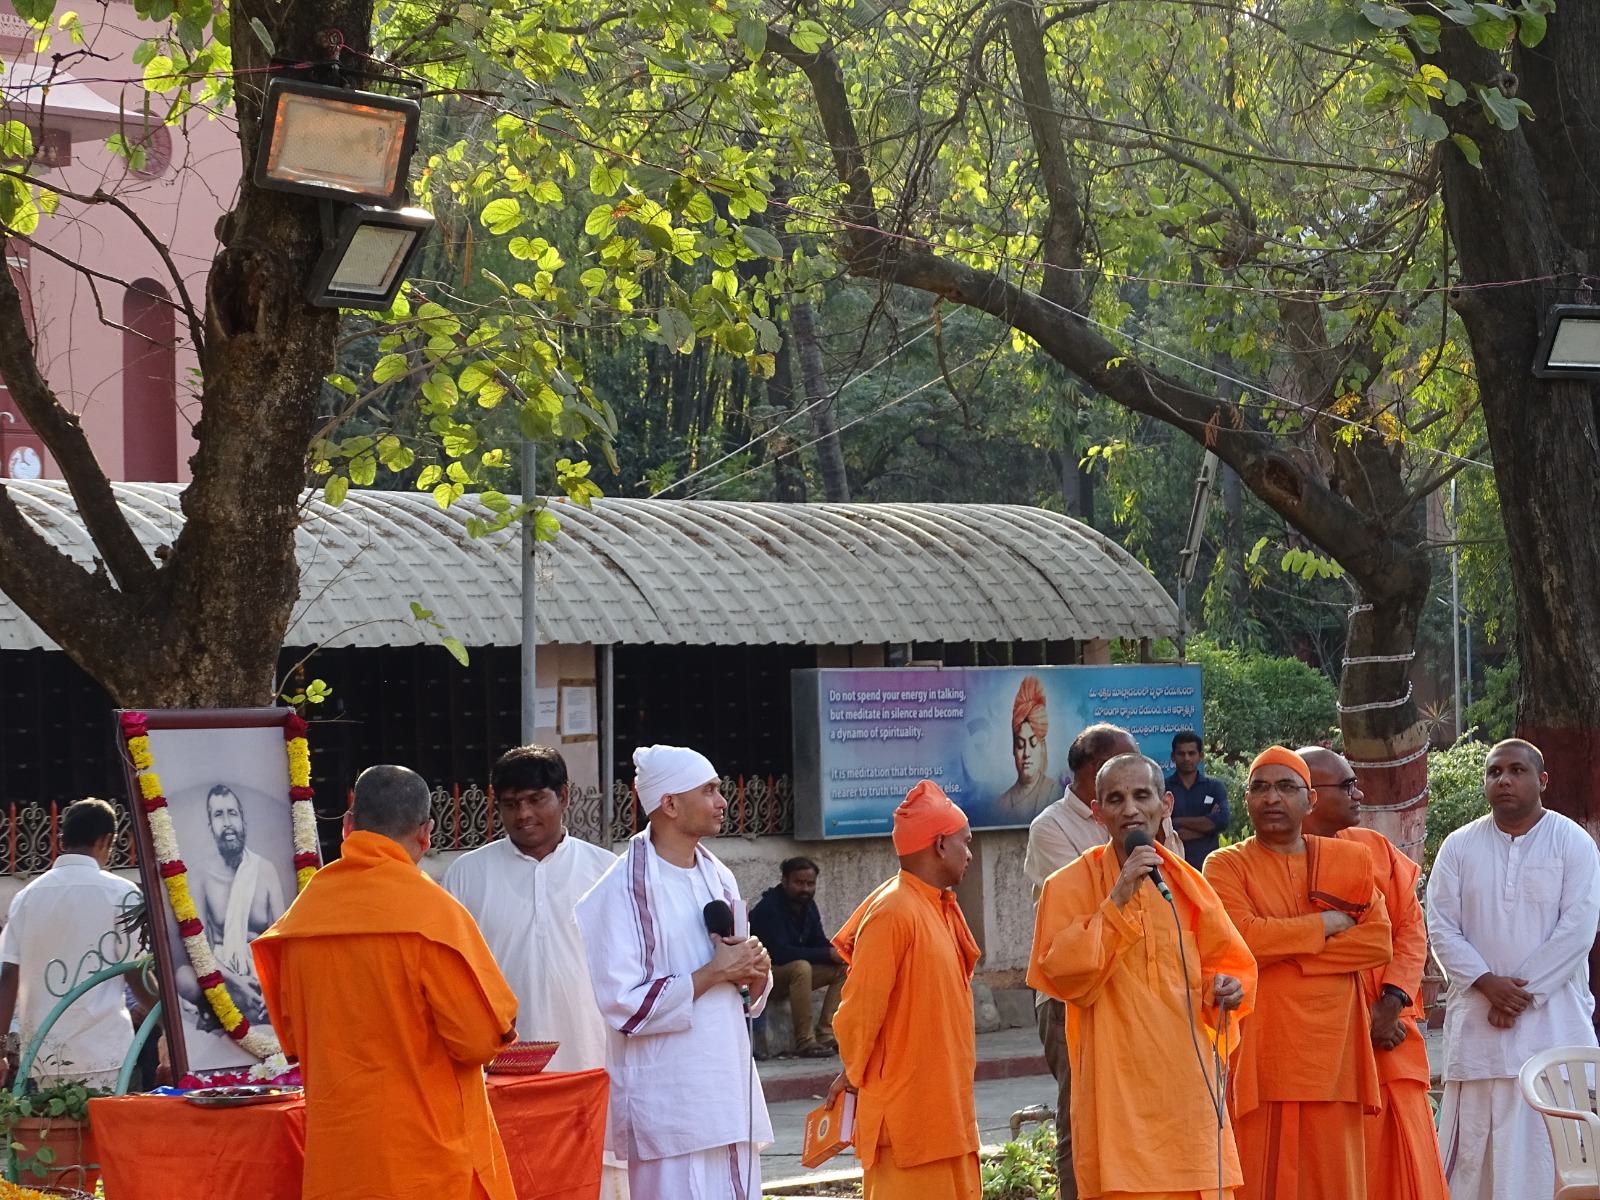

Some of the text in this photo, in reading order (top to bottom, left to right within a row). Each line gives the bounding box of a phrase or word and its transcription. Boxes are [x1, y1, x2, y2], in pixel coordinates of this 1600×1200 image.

[829, 687, 967, 703] Do not spend your energy in talking,
[830, 706, 963, 720] but meditate in silence and become
[830, 725, 924, 742] a dynamo of spirituality.
[831, 764, 943, 779] It is meditation that brings us
[832, 788, 858, 799] nearer
[859, 786, 868, 797] to
[869, 785, 889, 797] truth
[890, 783, 908, 796] than
[944, 781, 962, 793] else.
